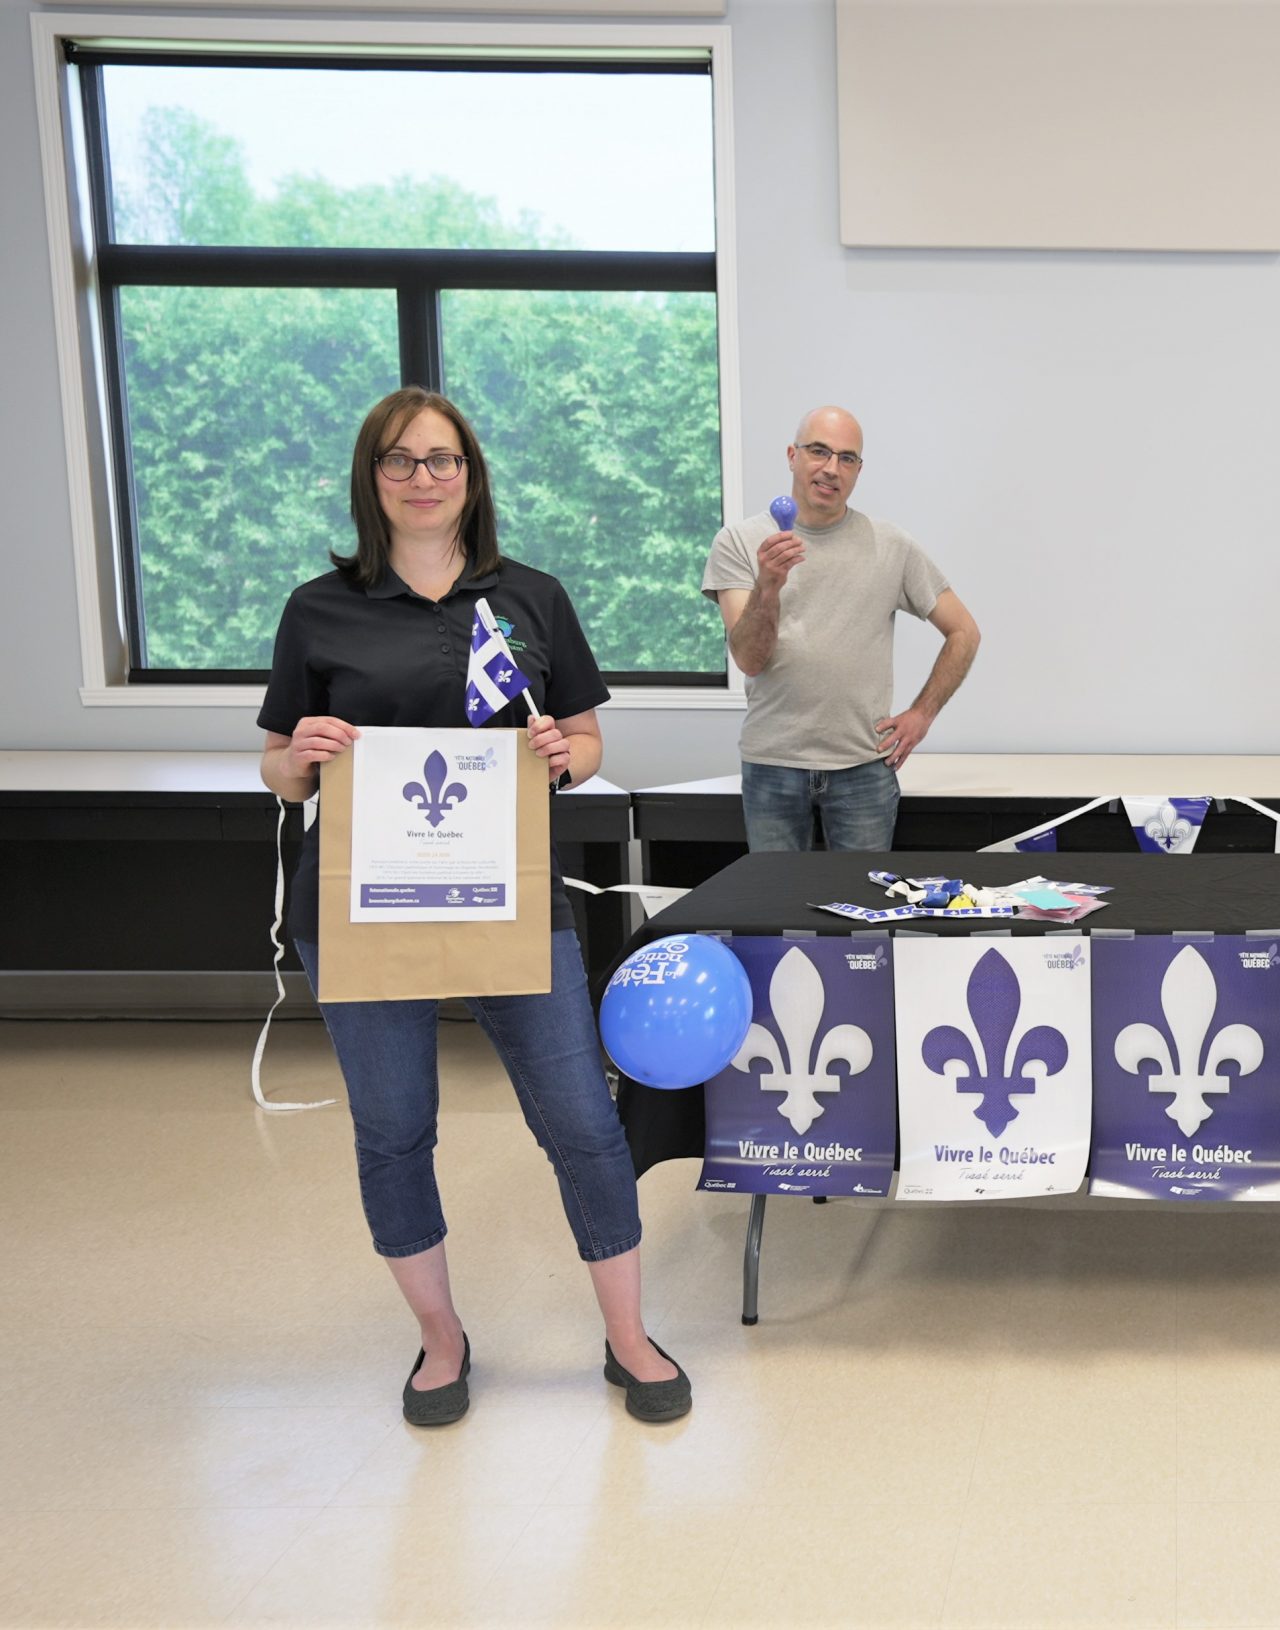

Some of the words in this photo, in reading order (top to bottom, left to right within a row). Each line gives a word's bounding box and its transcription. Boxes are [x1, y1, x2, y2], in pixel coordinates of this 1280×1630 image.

[437, 831, 463, 839] Québec
[849, 959, 877, 970] QUÉBEC
[1047, 959, 1074, 969] QUÉBEC
[1243, 958, 1270, 968] QUÉBEC
[612, 962, 669, 987] Fête
[739, 1140, 778, 1159] Vivre
[784, 1141, 798, 1159] le
[804, 1143, 862, 1161] Québec
[934, 1145, 973, 1162] Vivre
[979, 1146, 993, 1163] le
[999, 1146, 1056, 1165] Québec
[1125, 1143, 1167, 1161] Vivre
[1172, 1144, 1186, 1162] le
[1192, 1144, 1252, 1164] Québec
[763, 1164, 794, 1177] Tissé
[798, 1166, 831, 1177] serré
[959, 1167, 990, 1180] Tissé
[992, 1170, 1025, 1181] serré
[1151, 1166, 1185, 1178] Tissé
[1186, 1167, 1221, 1179] serré
